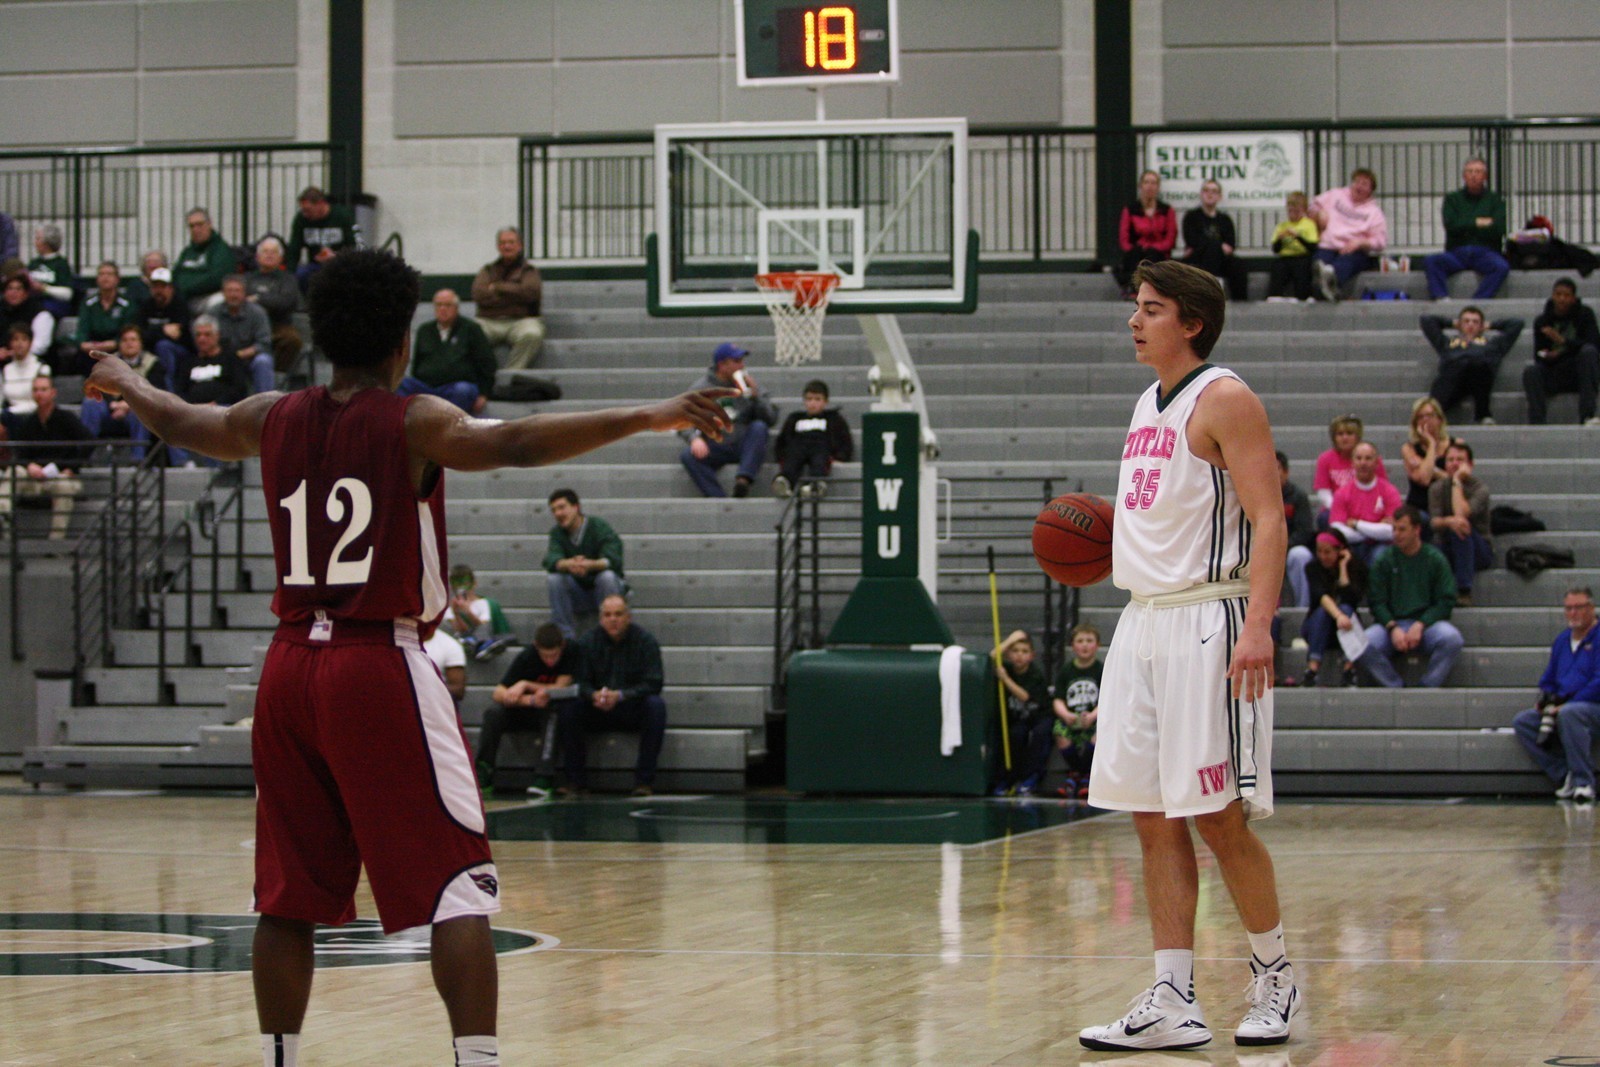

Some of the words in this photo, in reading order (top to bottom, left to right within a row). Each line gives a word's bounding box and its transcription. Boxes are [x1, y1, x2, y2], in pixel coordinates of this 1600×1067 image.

[804, 7, 855, 70] 18
[1156, 145, 1252, 161] STUDENT
[1159, 164, 1246, 180] SECTION
[1125, 468, 1161, 509] 35
[280, 477, 373, 585] 12
[1197, 761, 1228, 796] IW
